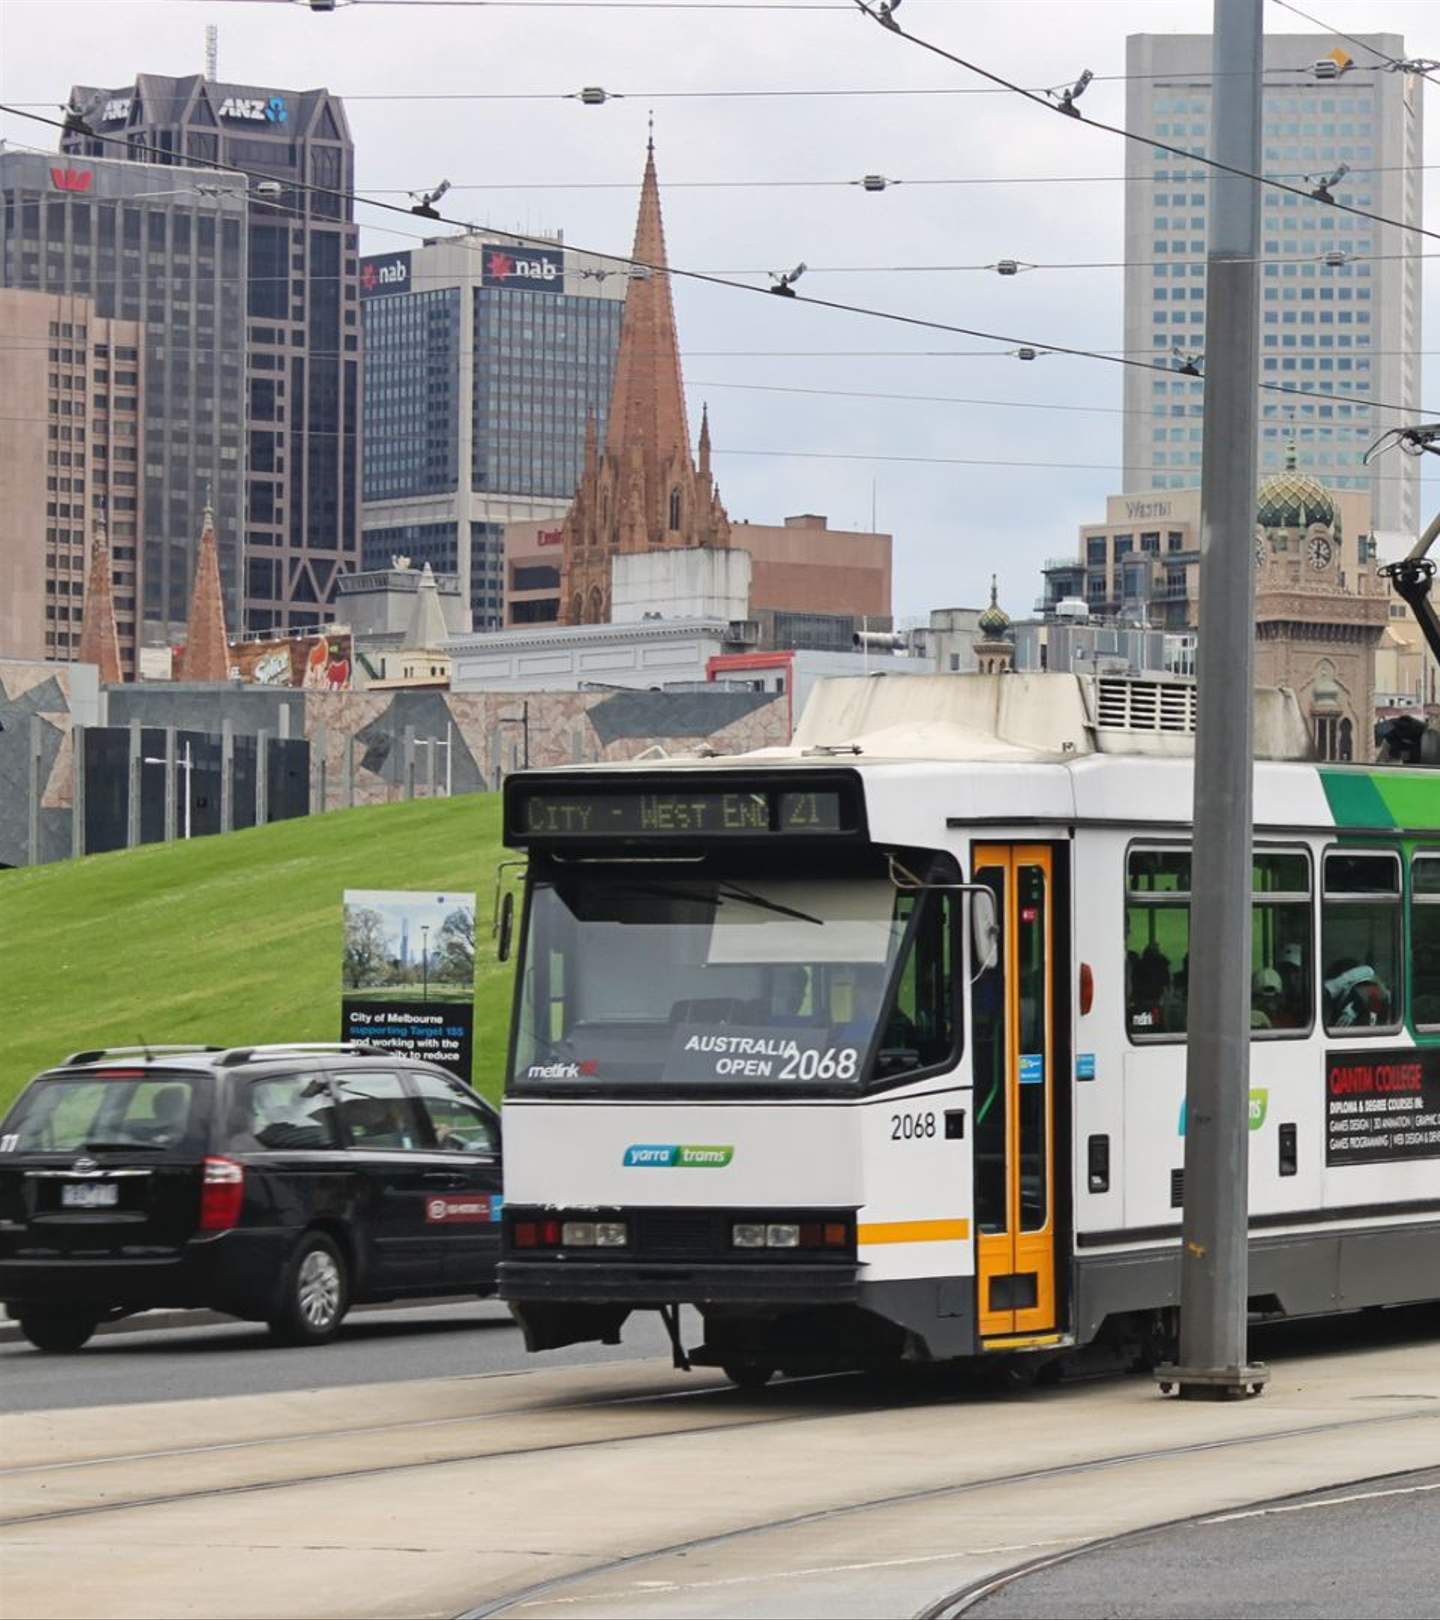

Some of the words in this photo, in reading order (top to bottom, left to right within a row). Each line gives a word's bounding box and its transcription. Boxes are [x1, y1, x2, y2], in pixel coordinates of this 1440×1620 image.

[218, 98, 266, 120] ANZ
[379, 259, 407, 284] nab
[515, 257, 557, 281] nab
[350, 1012, 372, 1024] City
[374, 1012, 386, 1023] of
[387, 1013, 444, 1024] Melbourne
[372, 1038, 415, 1049] working
[417, 1038, 440, 1048] with
[442, 1038, 460, 1048] the
[685, 1035, 800, 1056] AUSTRALIA
[423, 1050, 460, 1061] reduce
[778, 1048, 857, 1081] 2068
[527, 1063, 579, 1079] metlink
[715, 1058, 773, 1077] OPEN
[1375, 1063, 1423, 1092] COLLEGE
[891, 1111, 936, 1140] 2068
[630, 1149, 670, 1165] yarra
[683, 1149, 725, 1163] trams
